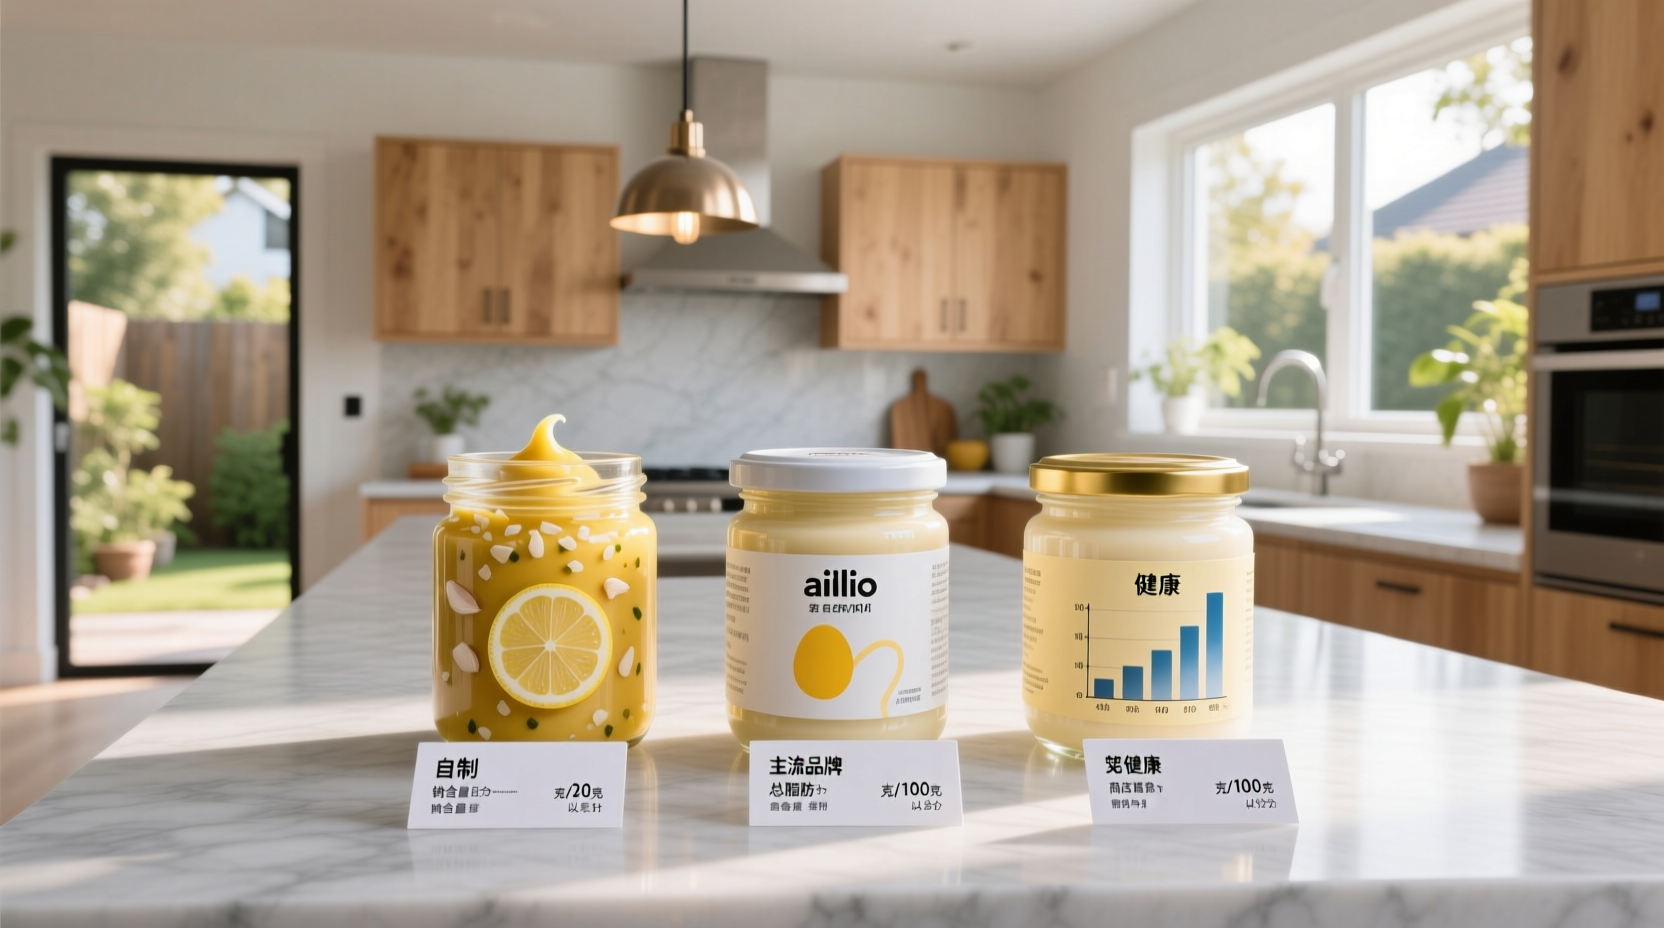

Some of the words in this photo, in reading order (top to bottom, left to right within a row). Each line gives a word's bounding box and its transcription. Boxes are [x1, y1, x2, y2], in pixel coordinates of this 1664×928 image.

[803, 569, 878, 597] aillio
[1134, 572, 1181, 596] 健康
[436, 757, 479, 780] 自制
[769, 755, 843, 776] 主流品牌
